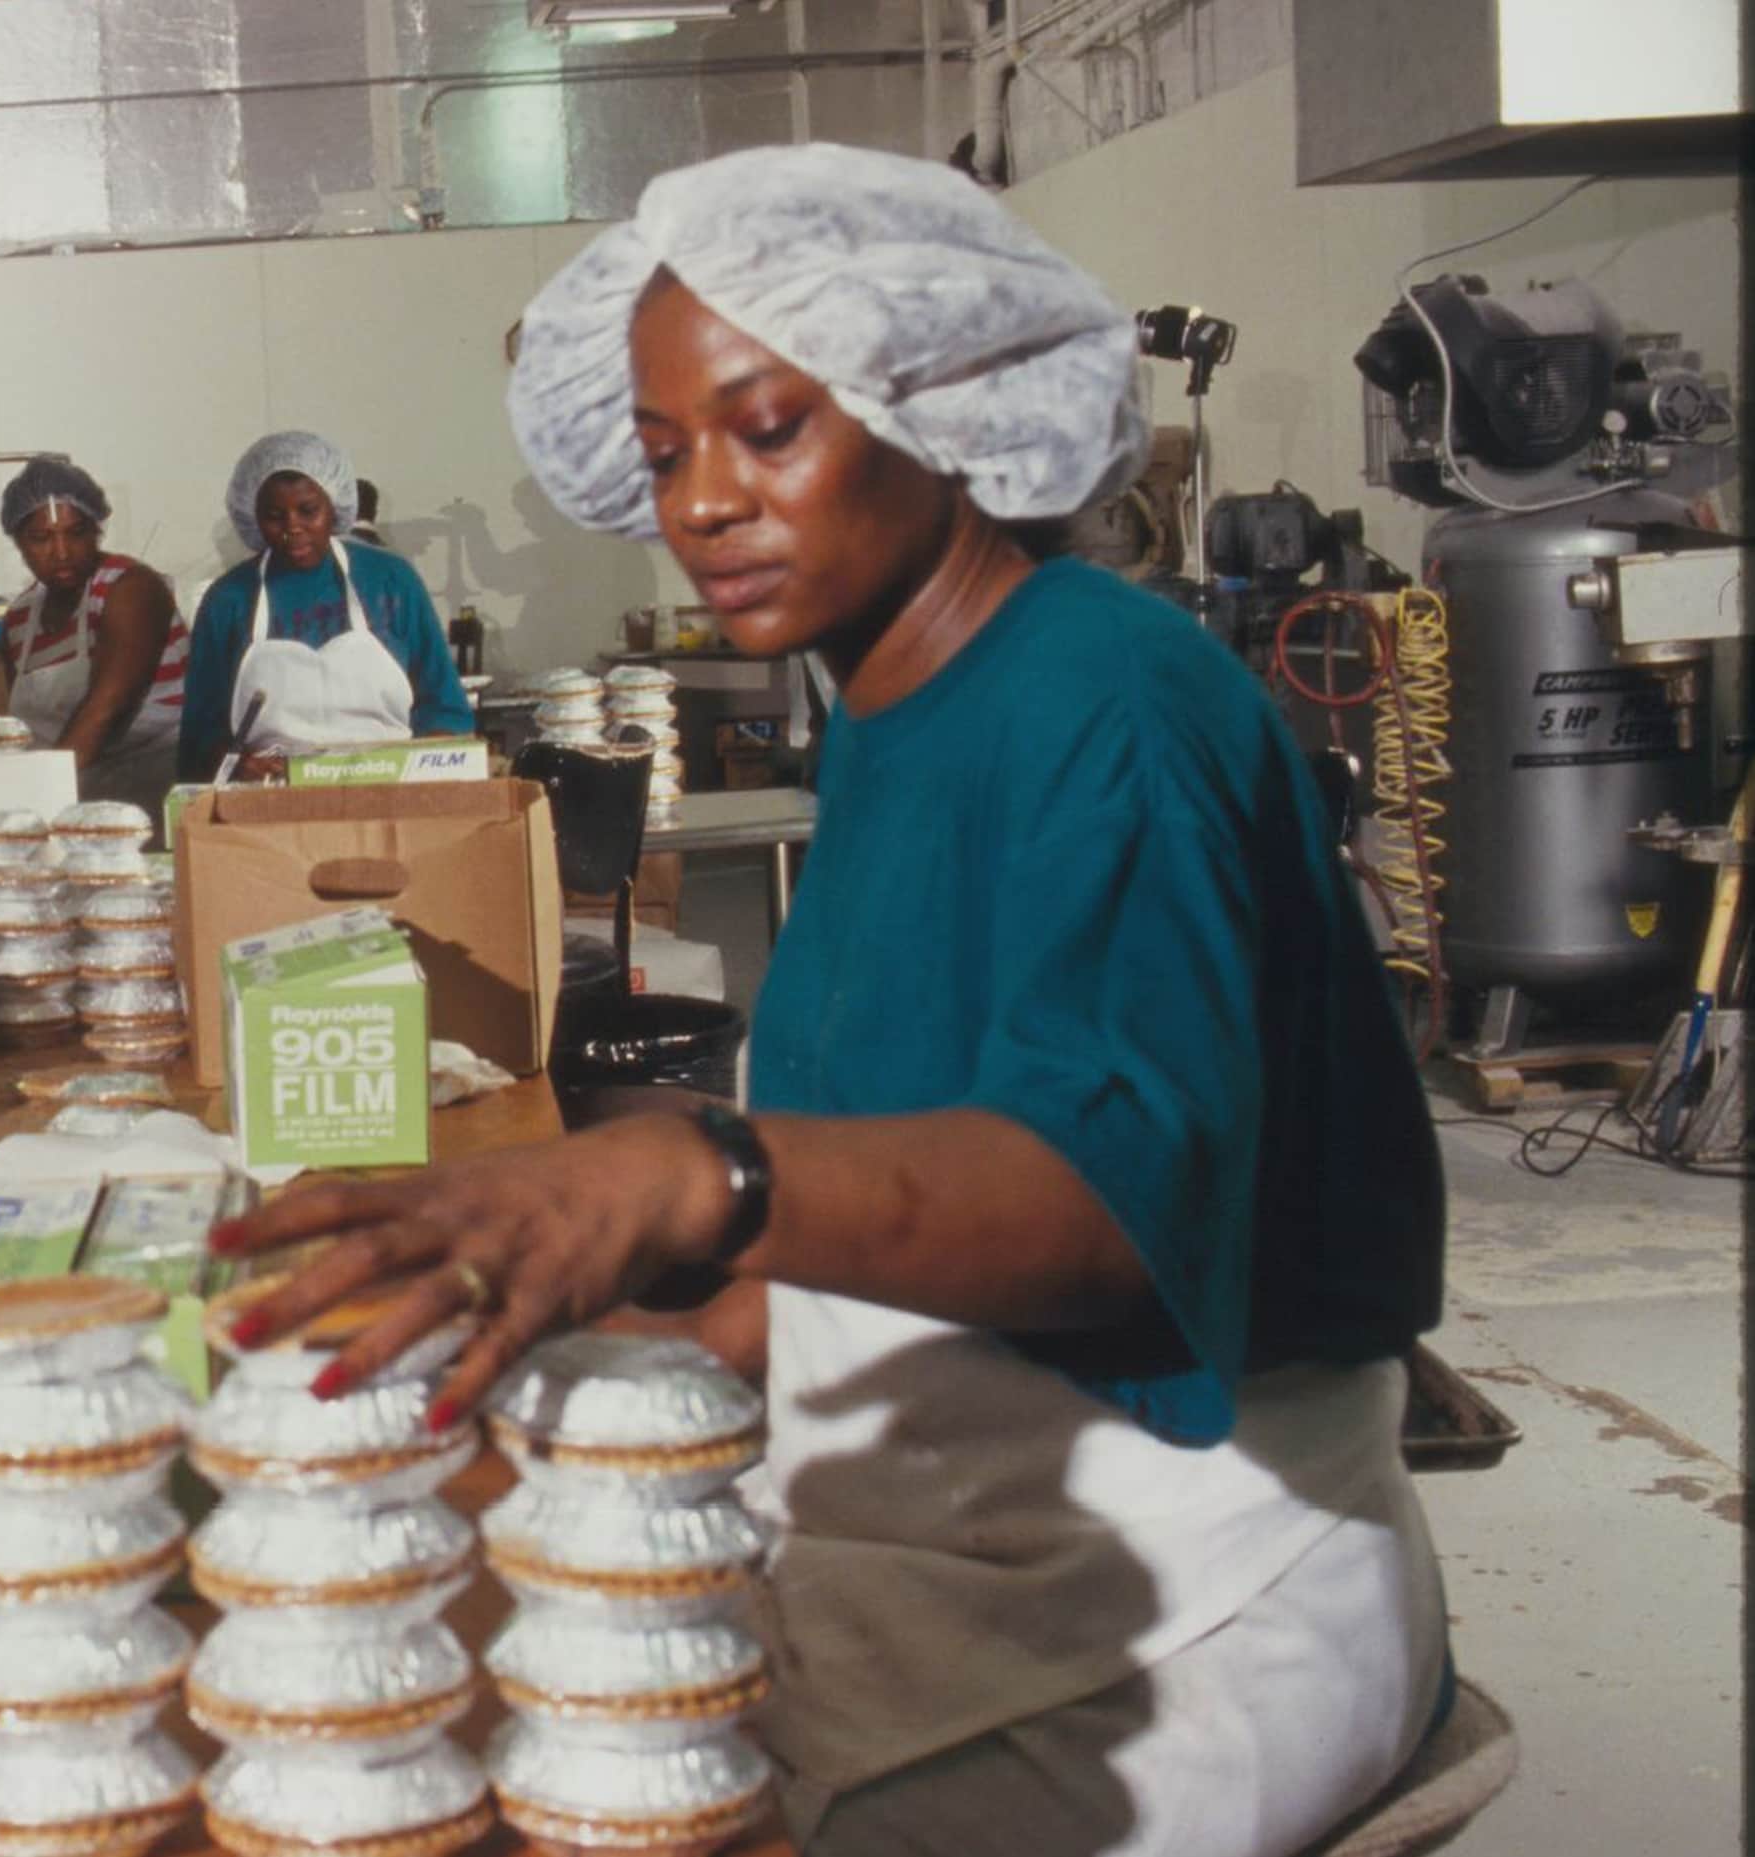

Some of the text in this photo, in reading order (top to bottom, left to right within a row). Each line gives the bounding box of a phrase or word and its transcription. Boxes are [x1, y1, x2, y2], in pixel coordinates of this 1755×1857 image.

[1538, 708, 1557, 731] 5
[1563, 706, 1601, 730] HP
[303, 751, 466, 781] Reynolds FILM
[270, 1003, 395, 1025] Reynolds
[271, 1025, 396, 1067] 905
[273, 1071, 396, 1116] FILM
